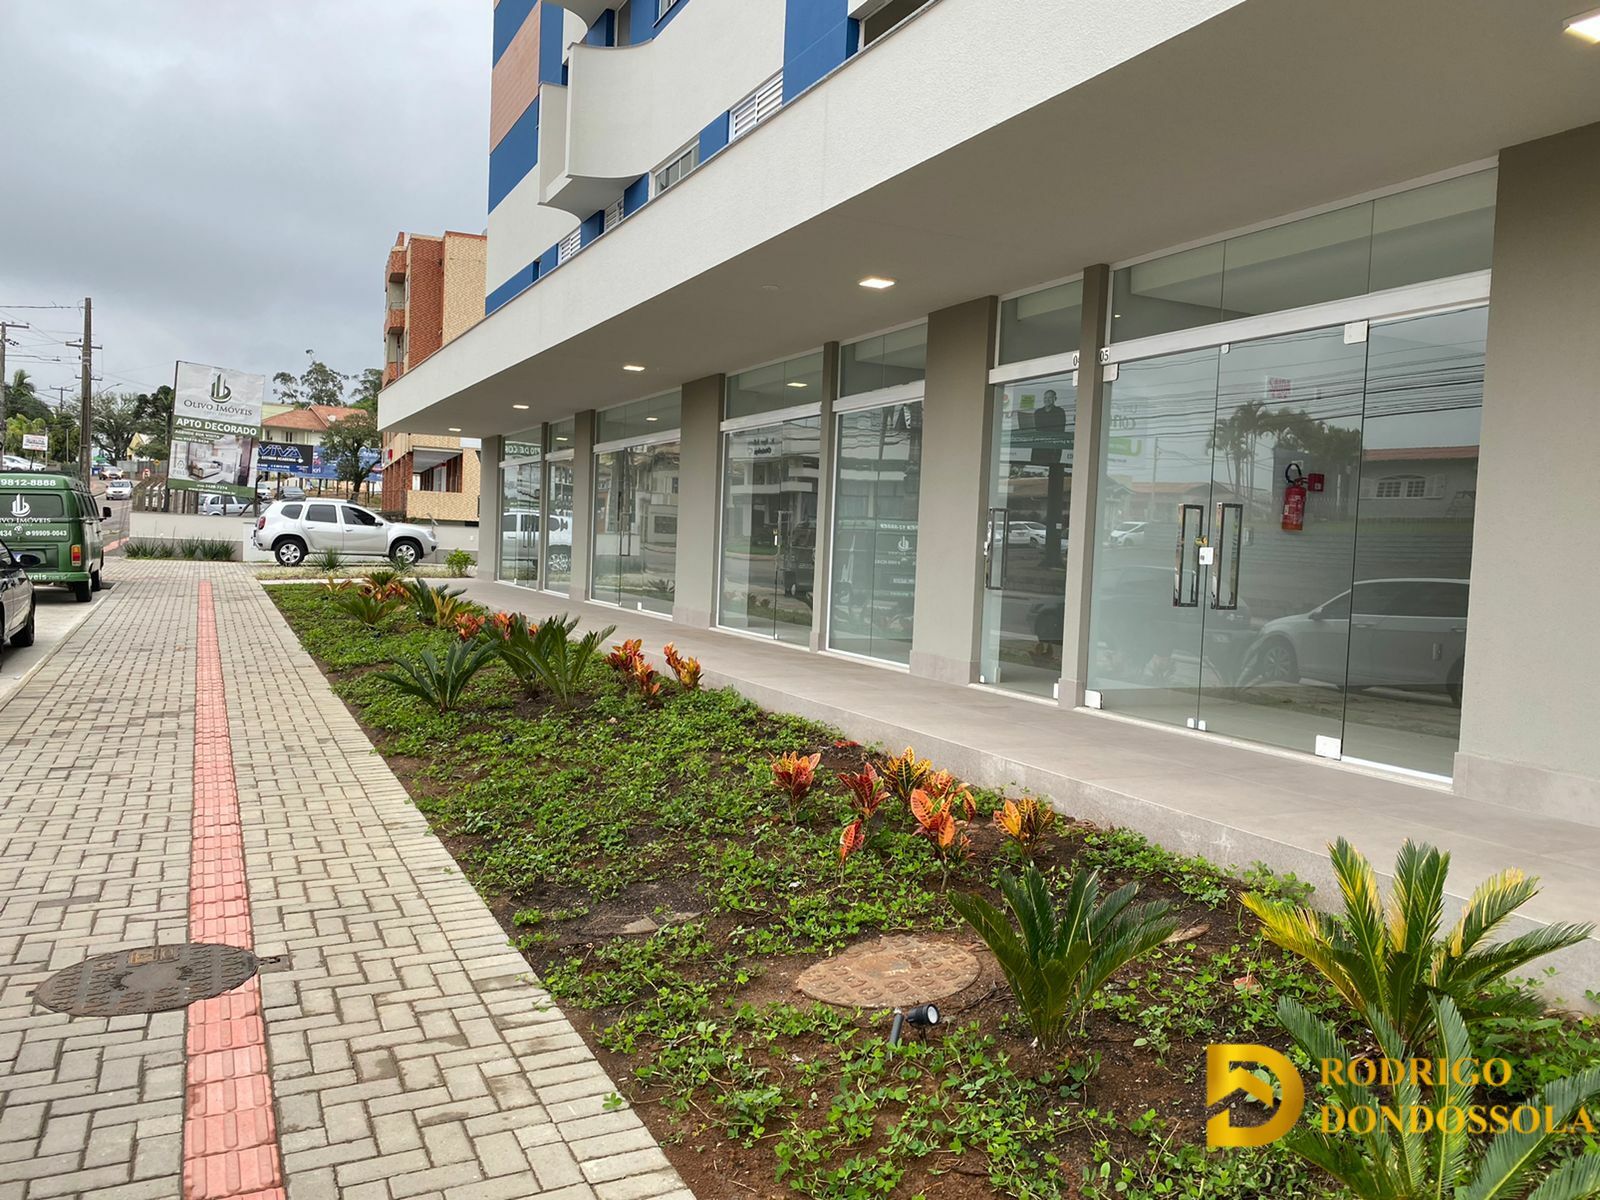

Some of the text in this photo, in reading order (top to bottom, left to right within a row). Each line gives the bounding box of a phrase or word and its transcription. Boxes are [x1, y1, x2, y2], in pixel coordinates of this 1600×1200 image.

[1072, 354, 1080, 367] 0
[1100, 349, 1109, 362] 05
[183, 399, 214, 411] OLIVO
[216, 403, 253, 417] IMÓVEIS
[176, 417, 257, 436] APTO DECORADO
